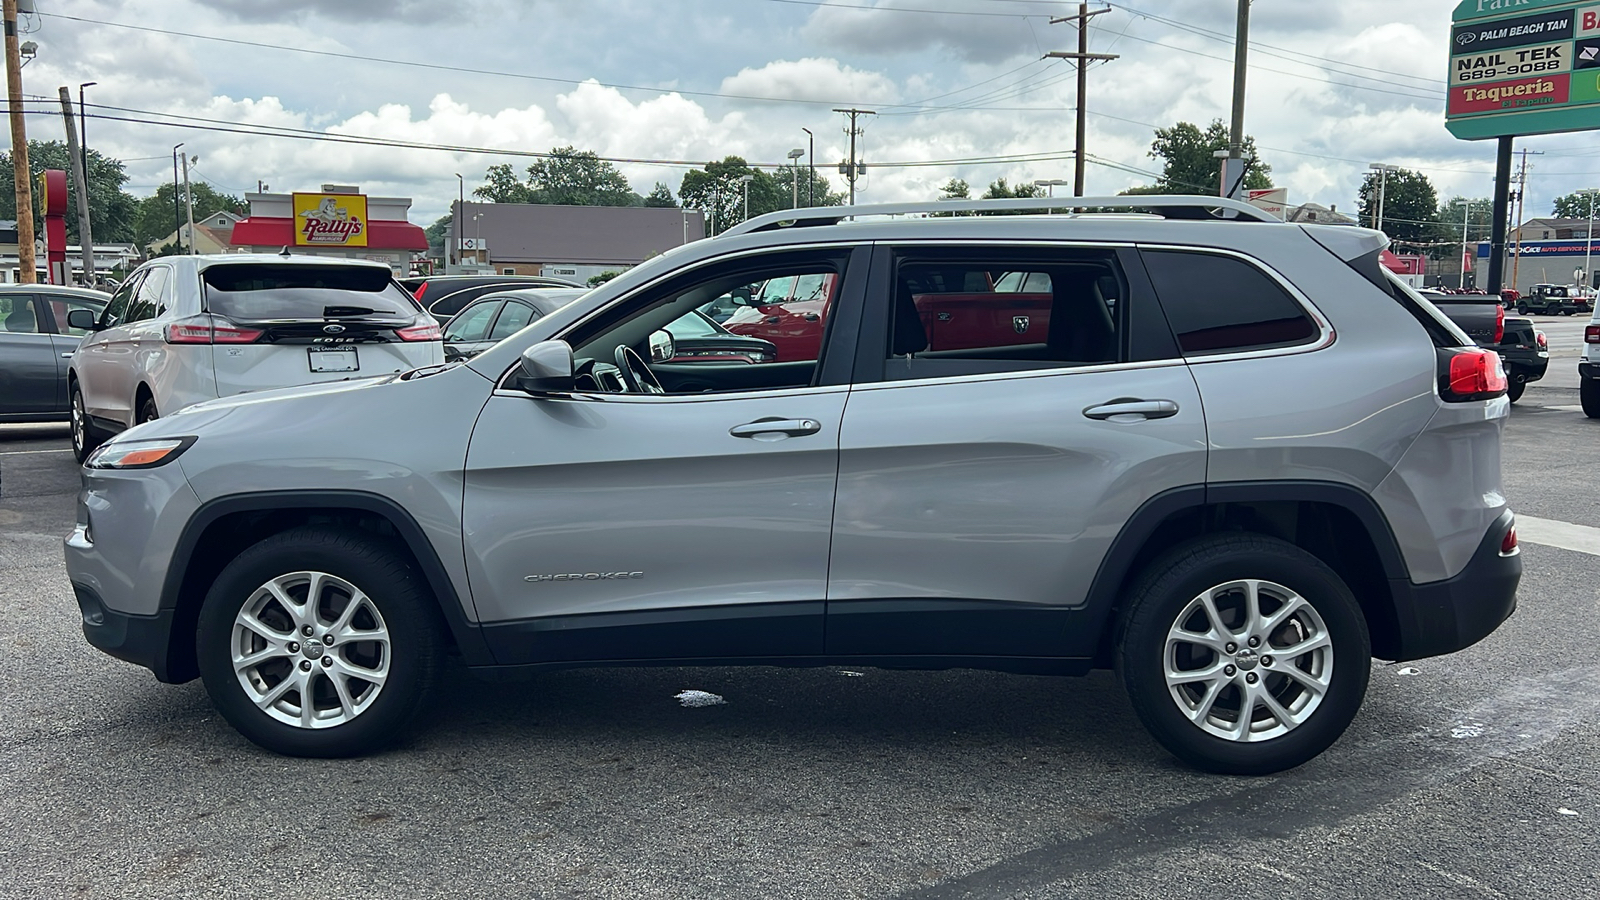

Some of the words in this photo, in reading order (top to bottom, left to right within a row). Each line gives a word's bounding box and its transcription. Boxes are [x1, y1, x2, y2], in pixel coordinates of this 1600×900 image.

[1480, 28, 1507, 41] PALM
[1509, 22, 1544, 37] BEACH
[1546, 19, 1568, 31] TAN
[1582, 11, 1600, 31] B
[1457, 54, 1505, 71] NAIL
[1516, 45, 1562, 63] TEK
[1459, 60, 1560, 81] 689-9088
[302, 216, 362, 242] Rally's
[524, 571, 644, 582] CHEROKEE
